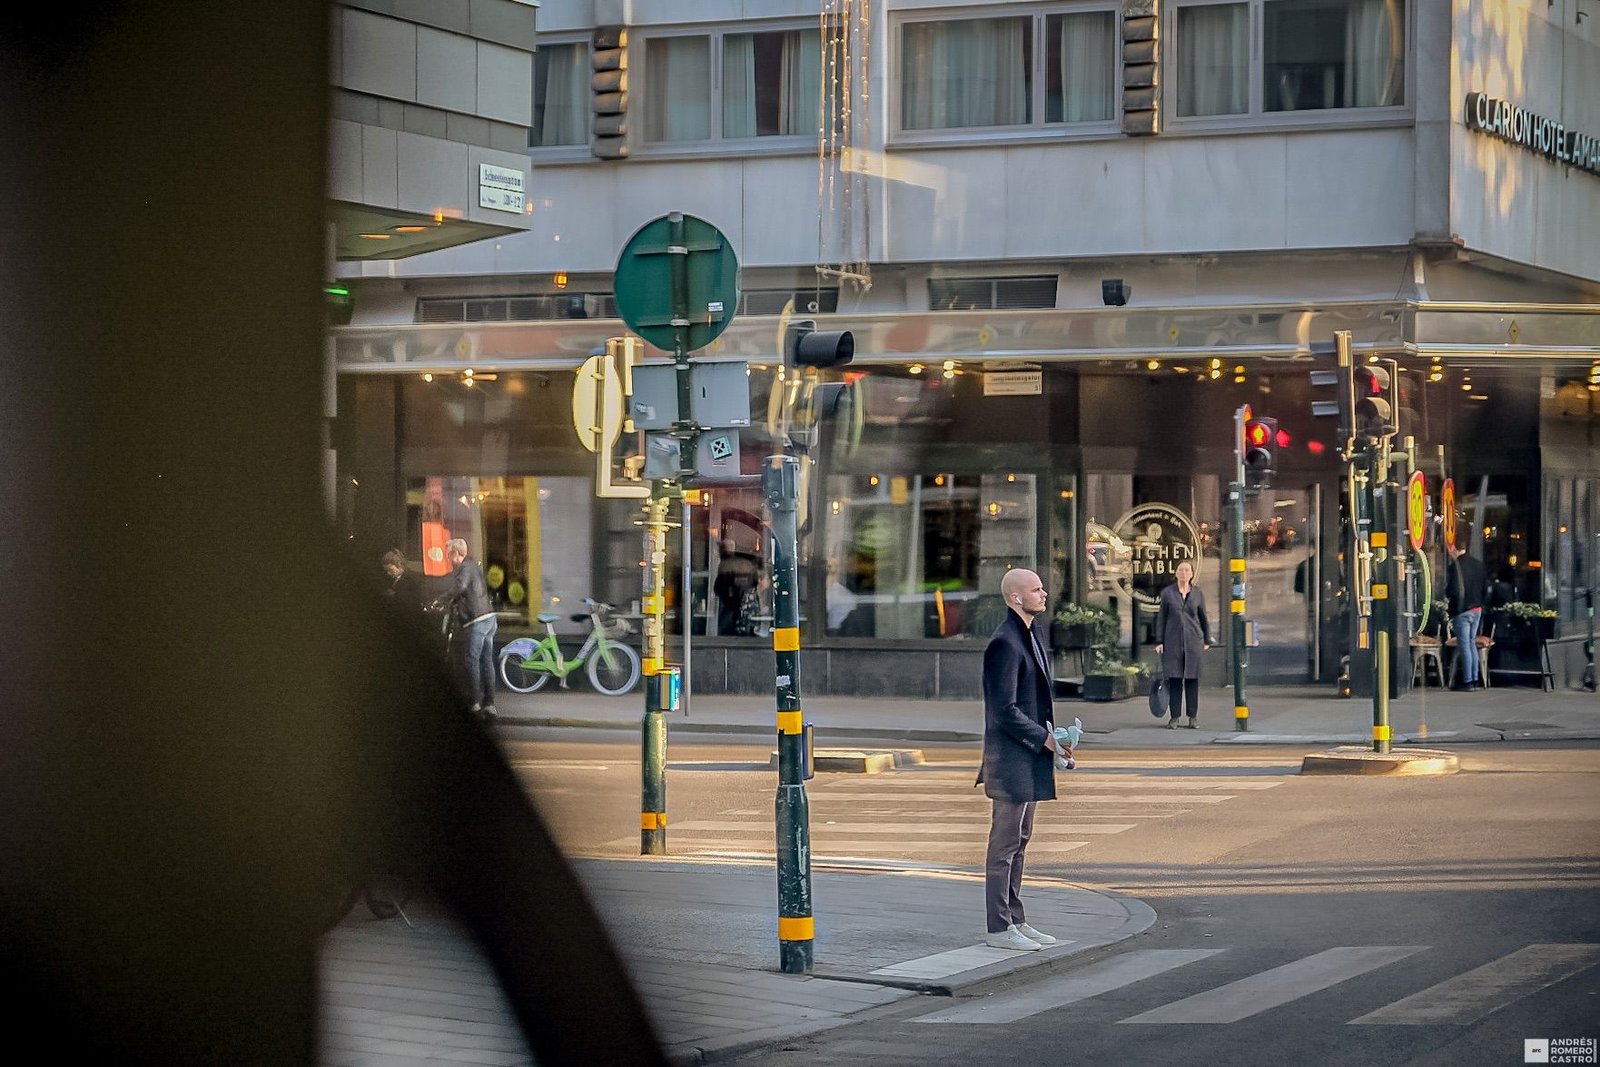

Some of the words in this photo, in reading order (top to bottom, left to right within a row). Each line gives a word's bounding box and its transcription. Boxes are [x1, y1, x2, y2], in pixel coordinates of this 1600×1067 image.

[1476, 93, 1532, 146] CLARION
[1533, 115, 1570, 160] HOTEL
[1133, 560, 1175, 574] TABL
